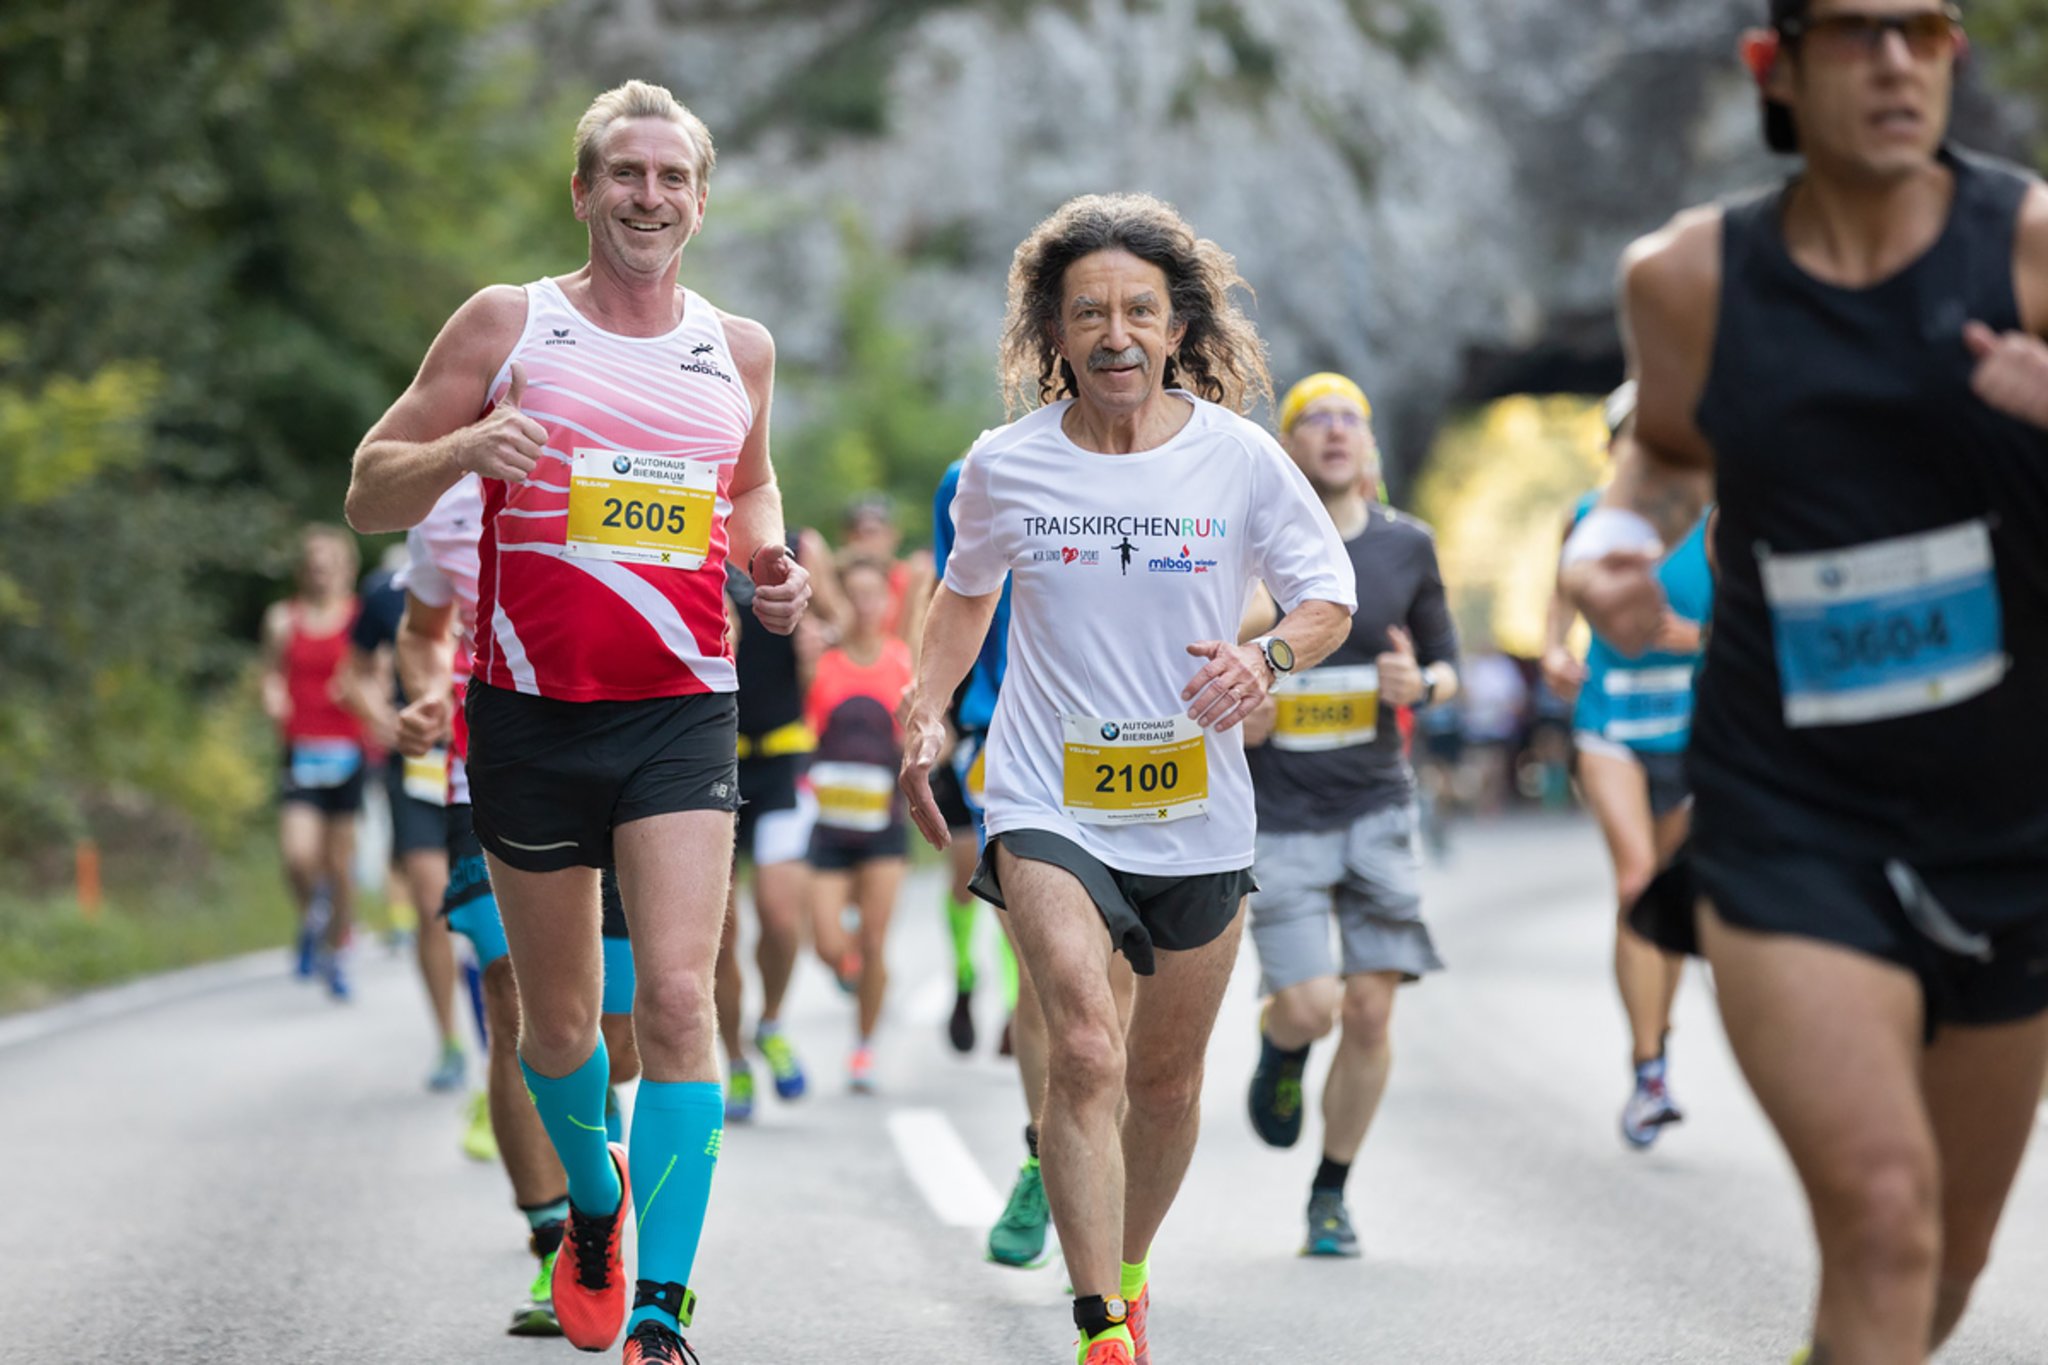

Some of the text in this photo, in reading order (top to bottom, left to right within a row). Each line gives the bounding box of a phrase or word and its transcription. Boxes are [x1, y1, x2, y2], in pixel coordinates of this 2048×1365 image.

[633, 457, 686, 470] AUTOHAUS
[632, 468, 685, 481] BIERBAUM
[602, 498, 685, 534] 2605
[1023, 516, 1226, 538] TRAISKIRCHENRUN
[1148, 557, 1192, 573] mibag
[1122, 719, 1175, 731] AUTOHAUS
[1122, 730, 1175, 742] BIERBAUM
[1095, 761, 1178, 793] 2100
